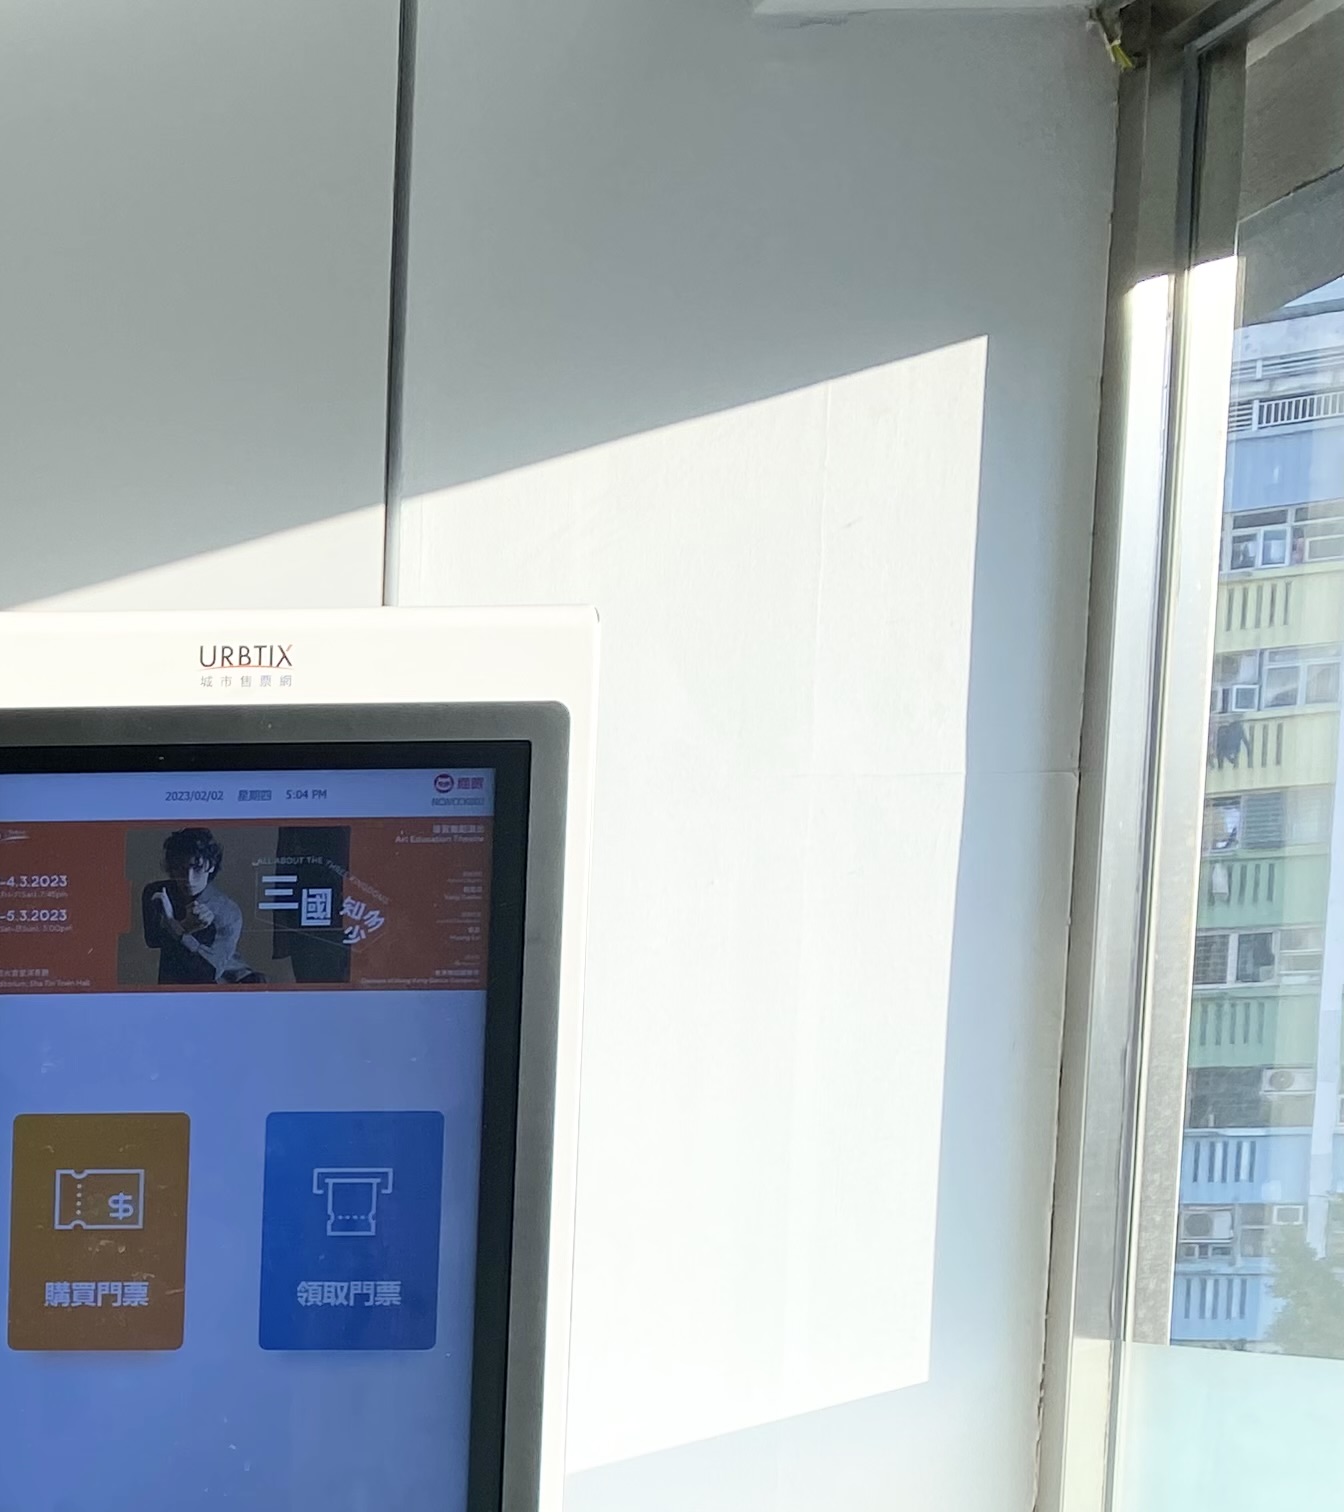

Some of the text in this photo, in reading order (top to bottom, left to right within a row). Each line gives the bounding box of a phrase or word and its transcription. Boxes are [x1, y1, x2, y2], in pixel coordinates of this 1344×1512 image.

[199, 644, 293, 668] URBTIX
[200, 675, 293, 688] 城市售票網
[164, 790, 224, 802] 2023/02/02
[285, 789, 327, 801] 5:04 PM
[276, 856, 305, 865] ABOUT
[306, 856, 323, 864] THE
[258, 875, 333, 926] 三國
[44, 1281, 150, 1308] 購買門票
[296, 1280, 402, 1307] 領取門票
